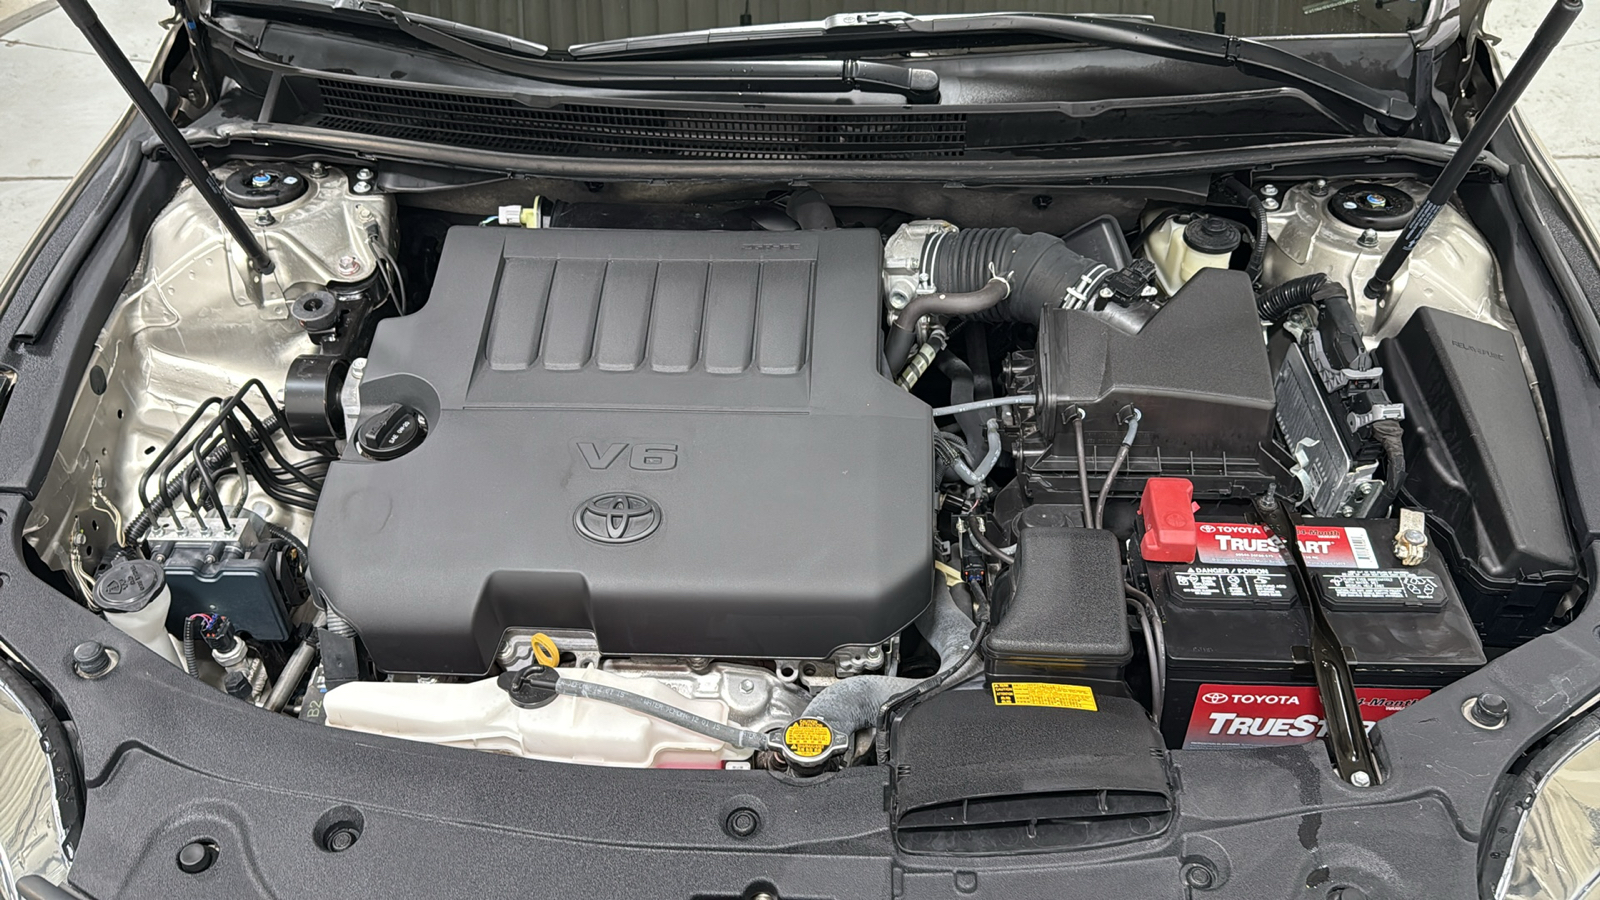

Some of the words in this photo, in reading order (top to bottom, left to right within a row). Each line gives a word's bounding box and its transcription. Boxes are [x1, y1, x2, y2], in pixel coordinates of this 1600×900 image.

[576, 442, 678, 471] V6
[1217, 526, 1260, 534] TOYOTA
[1231, 694, 1300, 705] TOYOTA
[307, 700, 323, 718] B2
